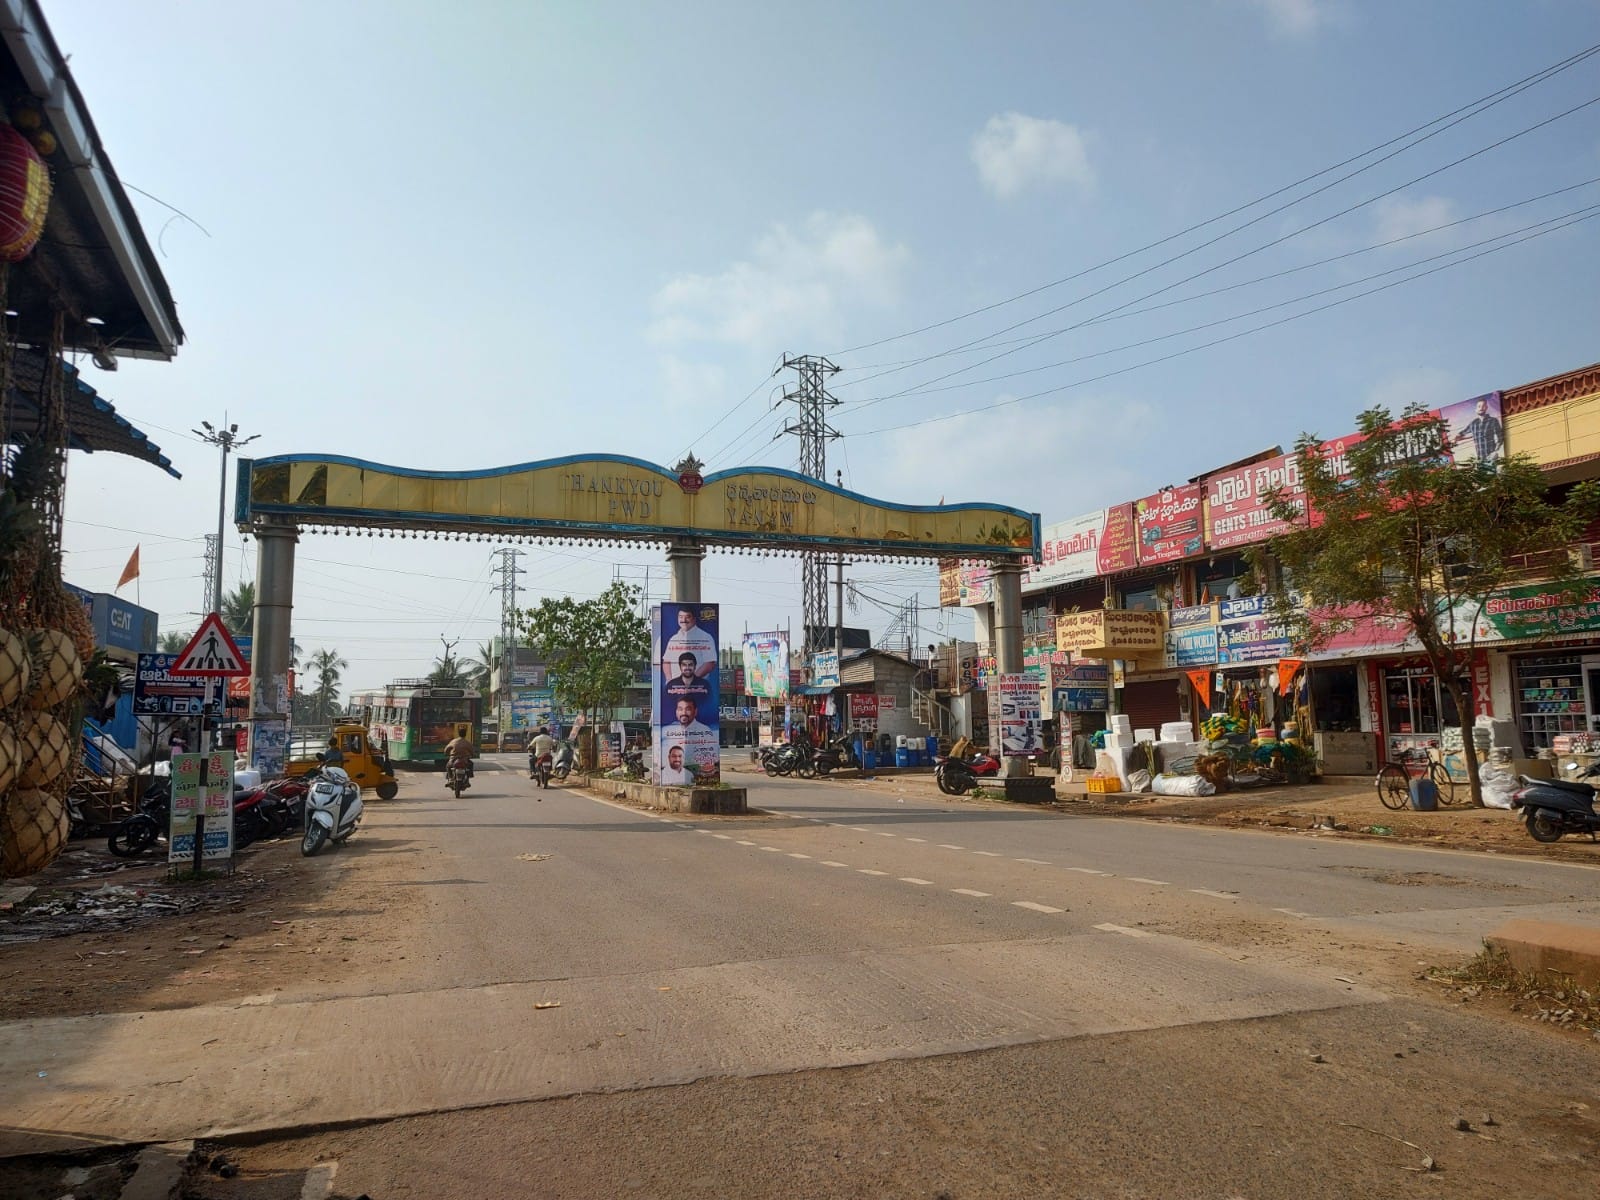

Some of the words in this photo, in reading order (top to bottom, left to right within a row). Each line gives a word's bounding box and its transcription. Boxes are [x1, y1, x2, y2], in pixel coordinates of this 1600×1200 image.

[608, 498, 652, 519] PWD
[1214, 514, 1246, 536] GENTS
[111, 608, 132, 631] CEAT
